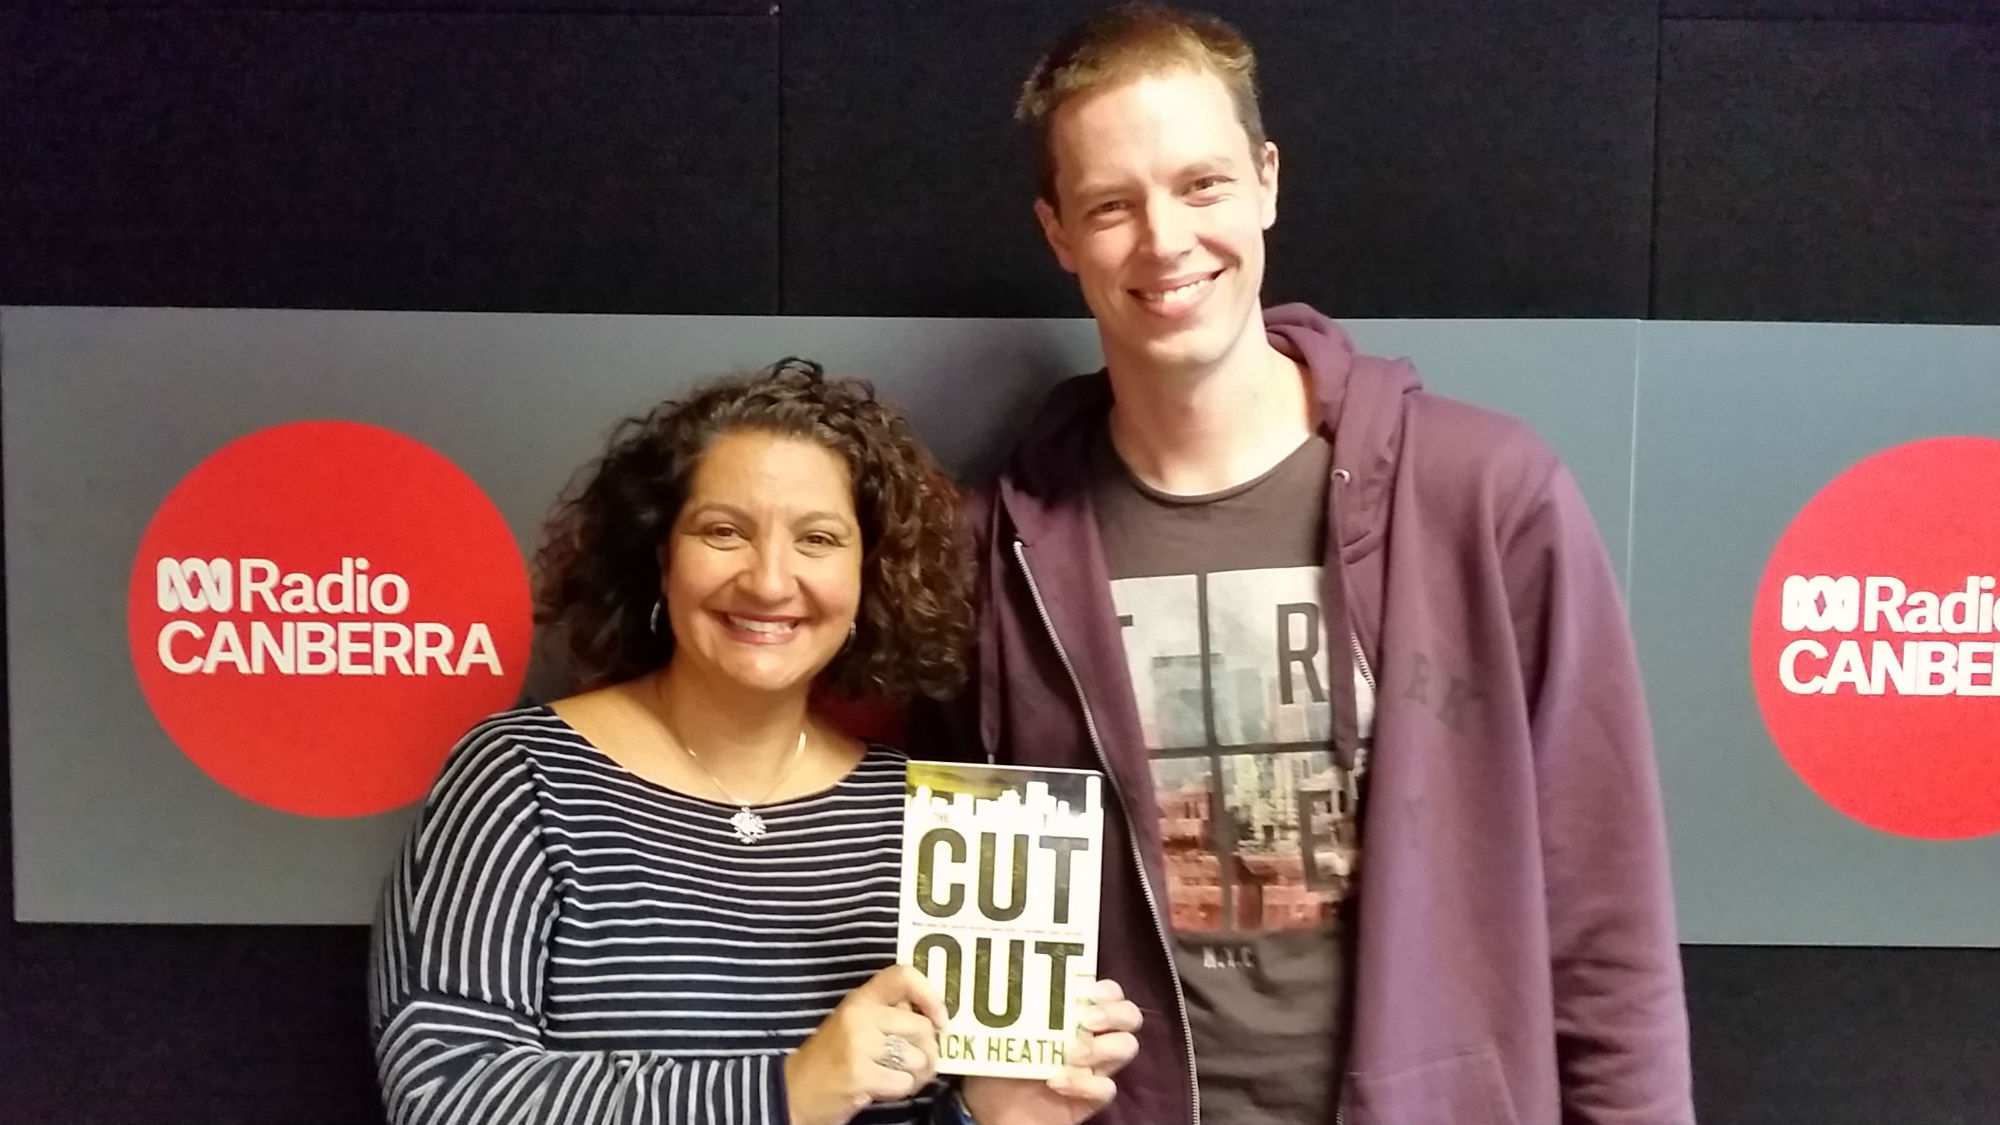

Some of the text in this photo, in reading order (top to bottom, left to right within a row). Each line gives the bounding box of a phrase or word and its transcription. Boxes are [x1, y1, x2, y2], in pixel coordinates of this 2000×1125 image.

[239, 556, 410, 614] Radio
[1863, 575, 2000, 634] Radi
[157, 620, 505, 676] CANBERRA
[1778, 639, 2000, 696] CANBE
[916, 827, 1089, 924] CUT
[913, 933, 1085, 1030] OUT
[987, 1036, 1065, 1065] HEATH
